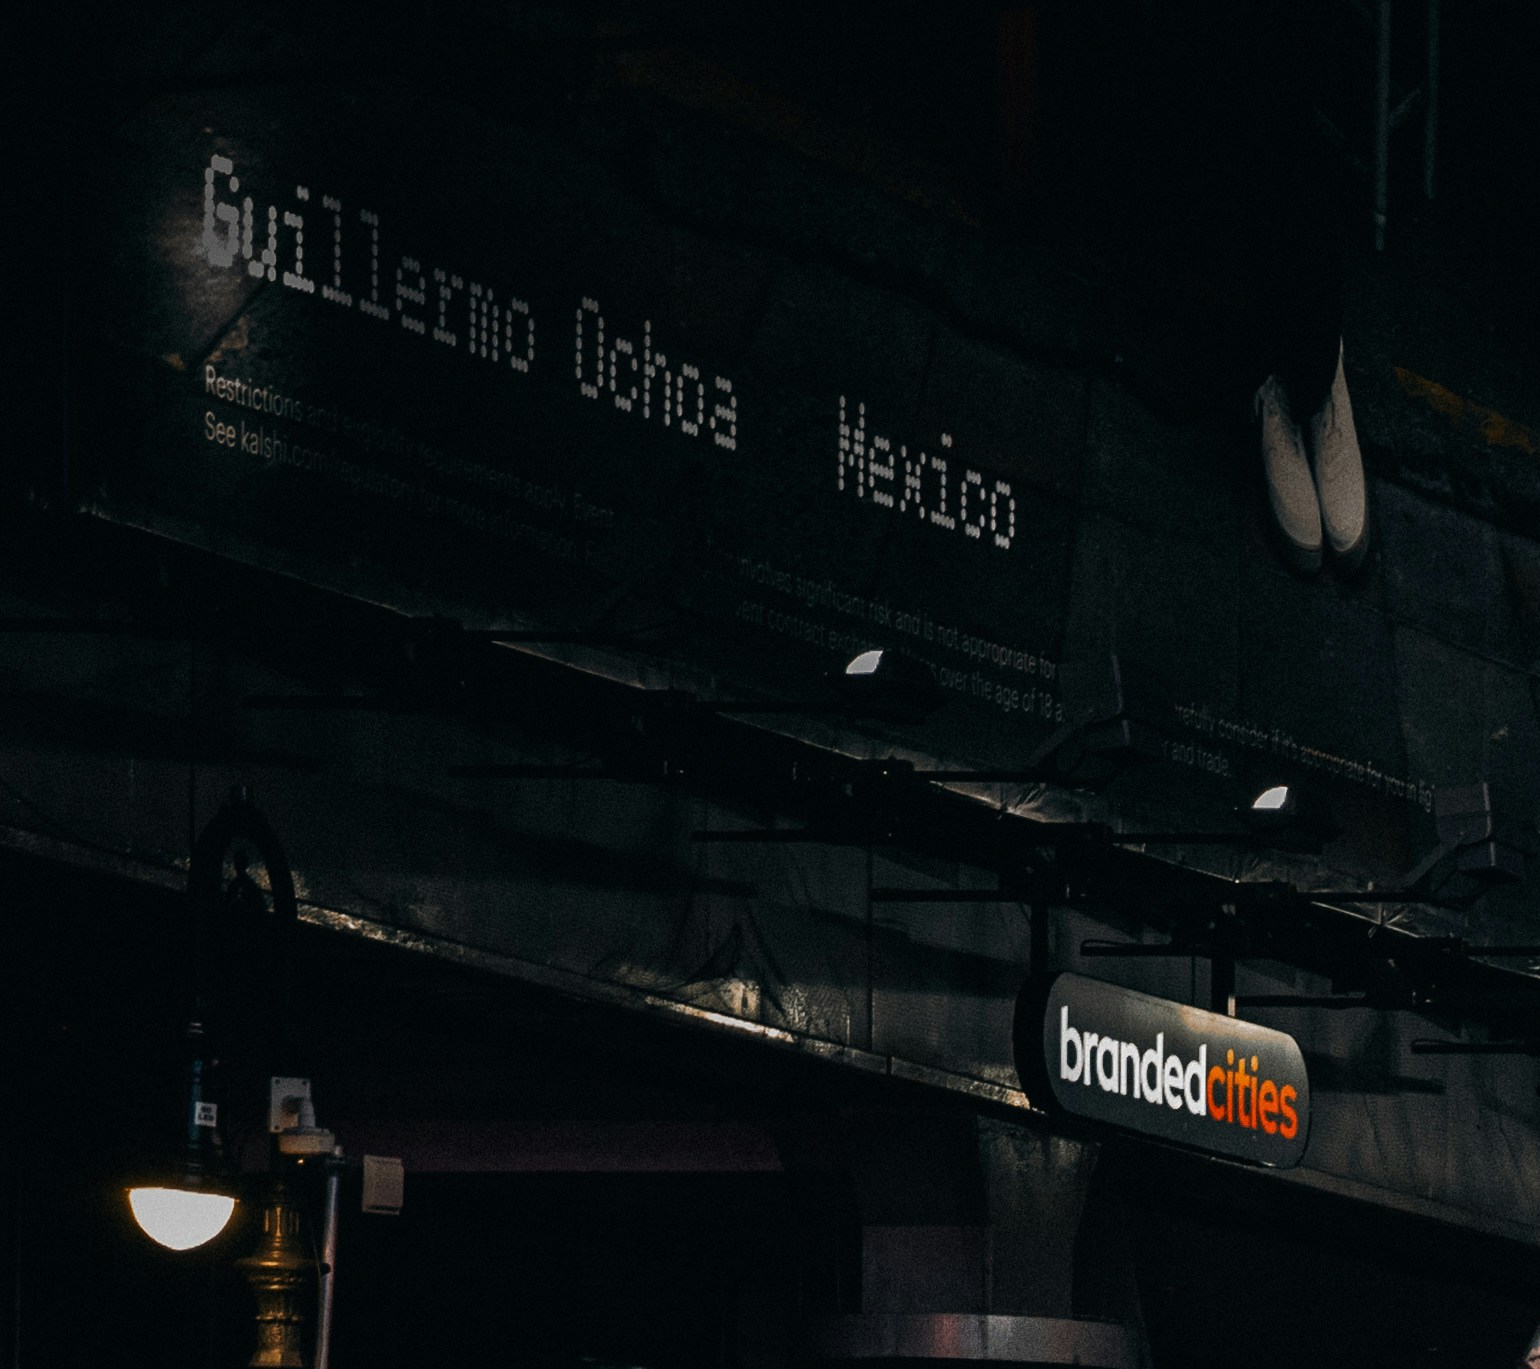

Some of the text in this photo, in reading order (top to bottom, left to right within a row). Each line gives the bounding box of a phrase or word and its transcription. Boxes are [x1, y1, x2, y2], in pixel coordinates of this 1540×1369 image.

[203, 153, 1016, 550] Guillermo Ochoa Mexico
[205, 364, 302, 425] Restrictions
[204, 409, 236, 448] See
[1060, 1005, 1298, 1139] brandedcities
